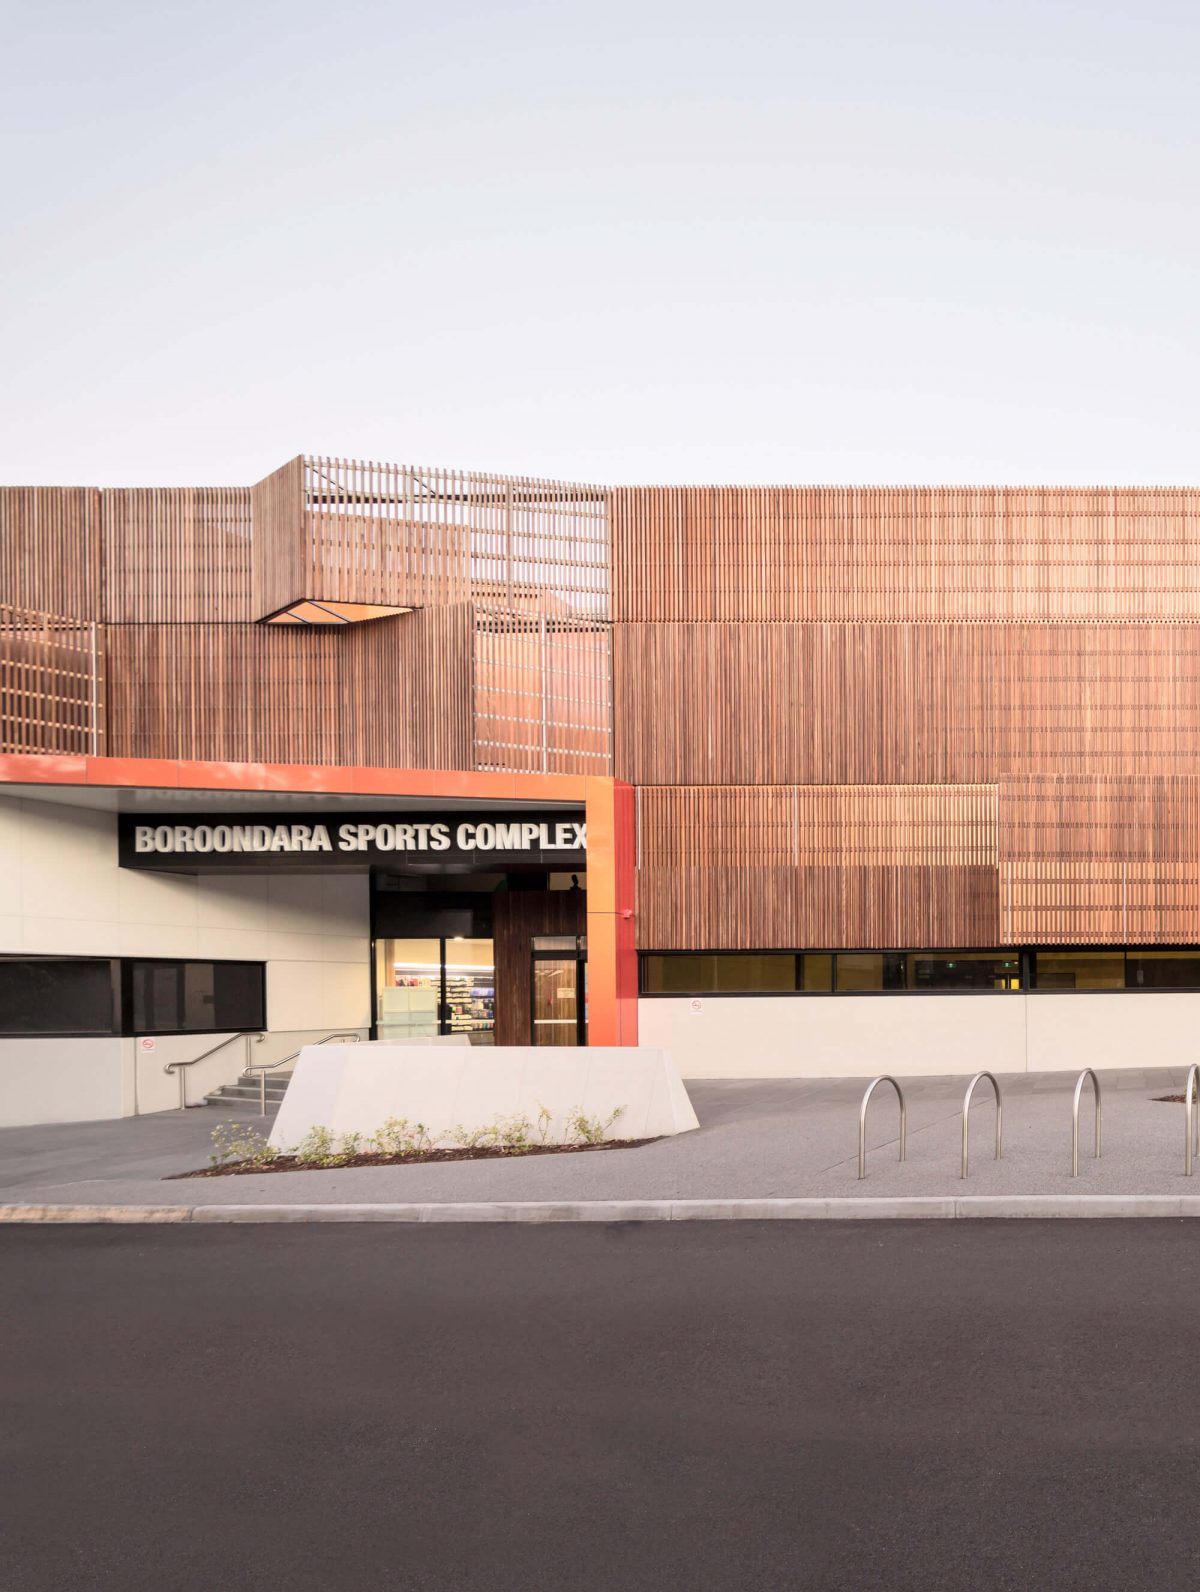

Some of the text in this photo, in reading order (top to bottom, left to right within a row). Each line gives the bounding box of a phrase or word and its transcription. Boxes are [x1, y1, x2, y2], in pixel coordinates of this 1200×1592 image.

[135, 823, 587, 852] BOROONDARA SPORTS COMPLEX
